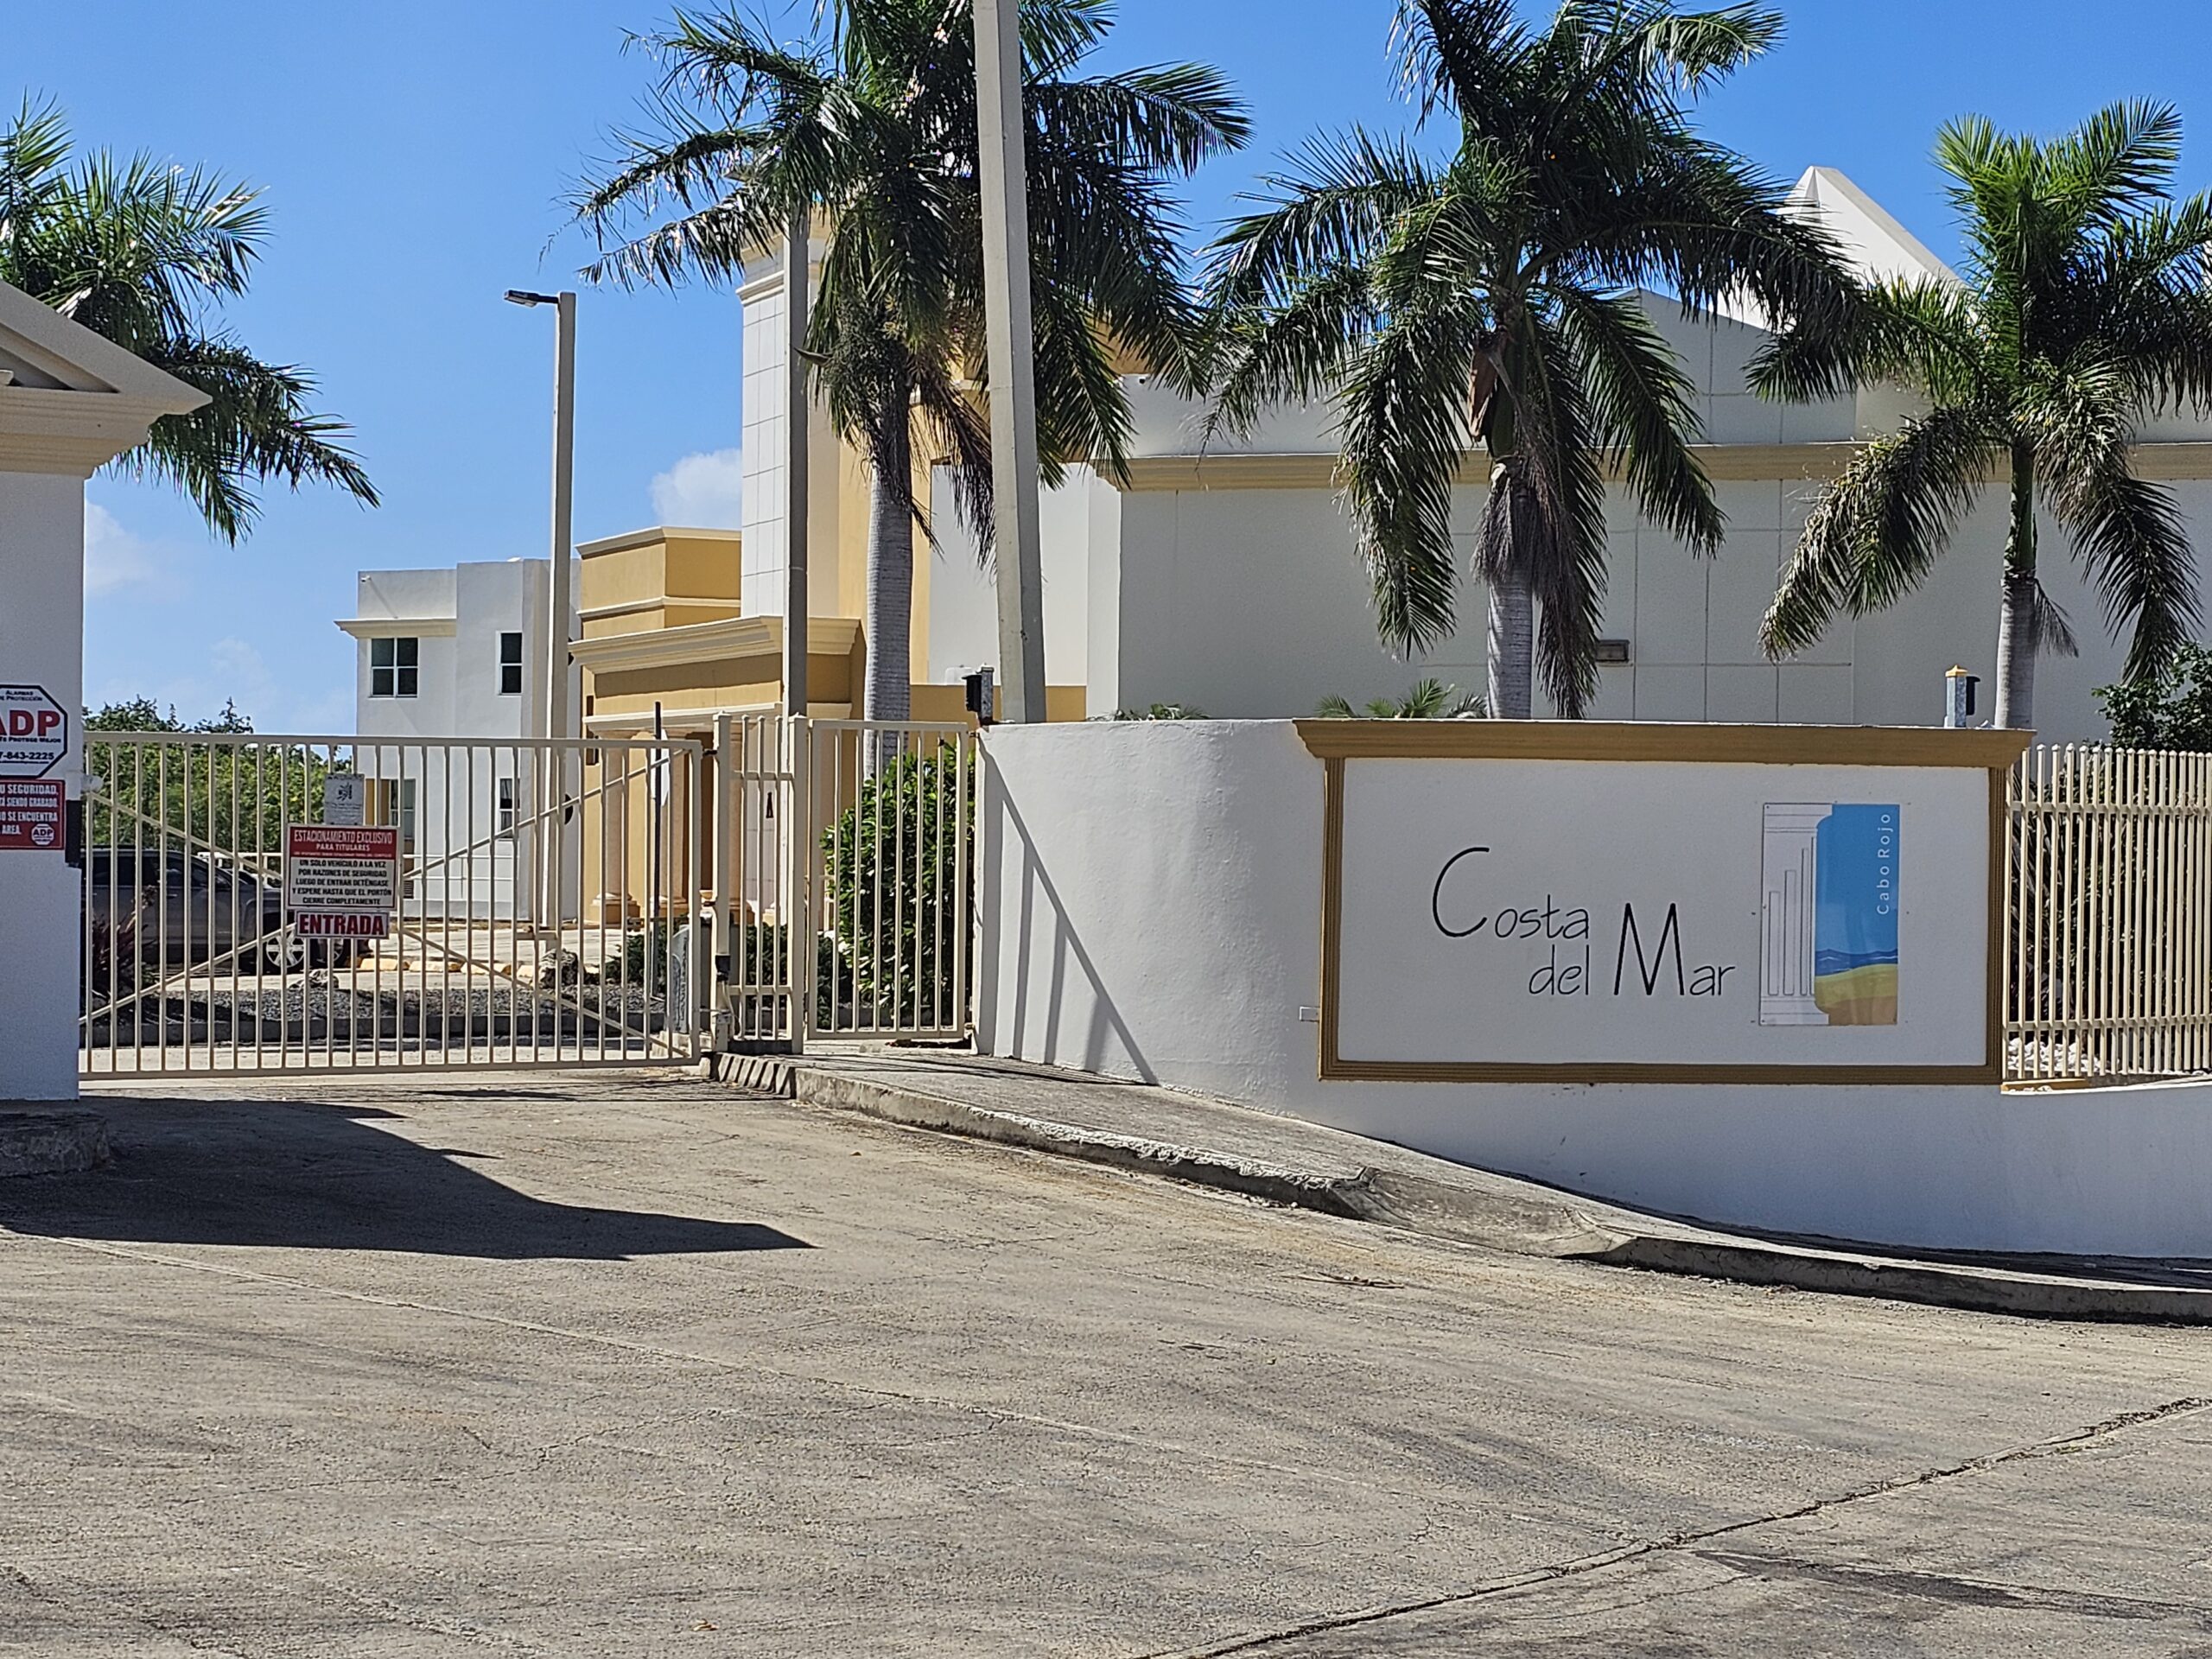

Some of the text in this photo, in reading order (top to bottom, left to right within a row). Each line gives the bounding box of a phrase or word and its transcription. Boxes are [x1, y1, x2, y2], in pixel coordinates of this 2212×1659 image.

[0, 709, 60, 736] DP
[8, 811, 16, 822] SE
[17, 811, 58, 822] ENCUENTRA
[294, 830, 392, 844] ESTACIONAMIENTO EXCLUSIVO
[1876, 814, 1894, 915] Cabo Rojo
[1433, 846, 1590, 939] Costa
[299, 914, 385, 935] ENTRADA
[1529, 902, 1737, 996] del Mar
